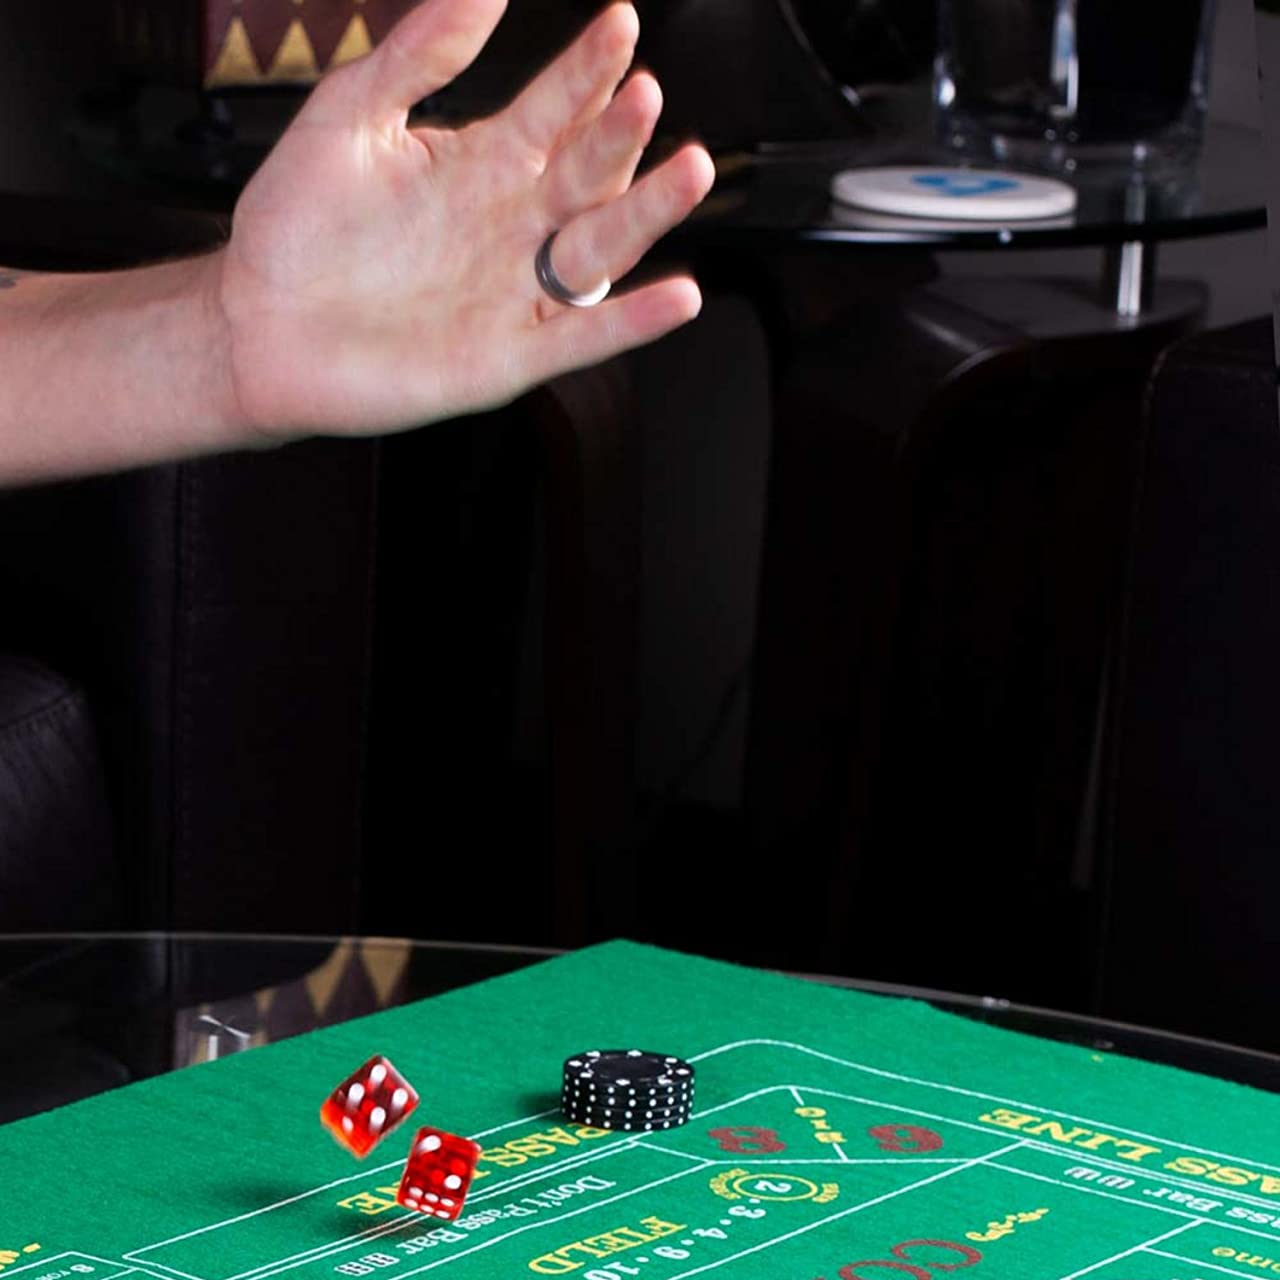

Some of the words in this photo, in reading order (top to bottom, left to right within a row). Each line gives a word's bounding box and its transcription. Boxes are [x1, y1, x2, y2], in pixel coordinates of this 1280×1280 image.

[708, 1126, 787, 1153] 8
[979, 1109, 1162, 1161] LINE
[531, 1175, 616, 1207] Don't
[756, 1179, 792, 1194] 2
[728, 1205, 766, 1219] 3
[1142, 1188, 1224, 1212] Bar
[453, 1198, 538, 1230] Pass
[396, 1227, 468, 1255] Bar
[528, 1216, 687, 1275] FIELD
[692, 1227, 728, 1240] 4
[652, 1246, 690, 1260] 9
[71, 1264, 95, 1273] 8
